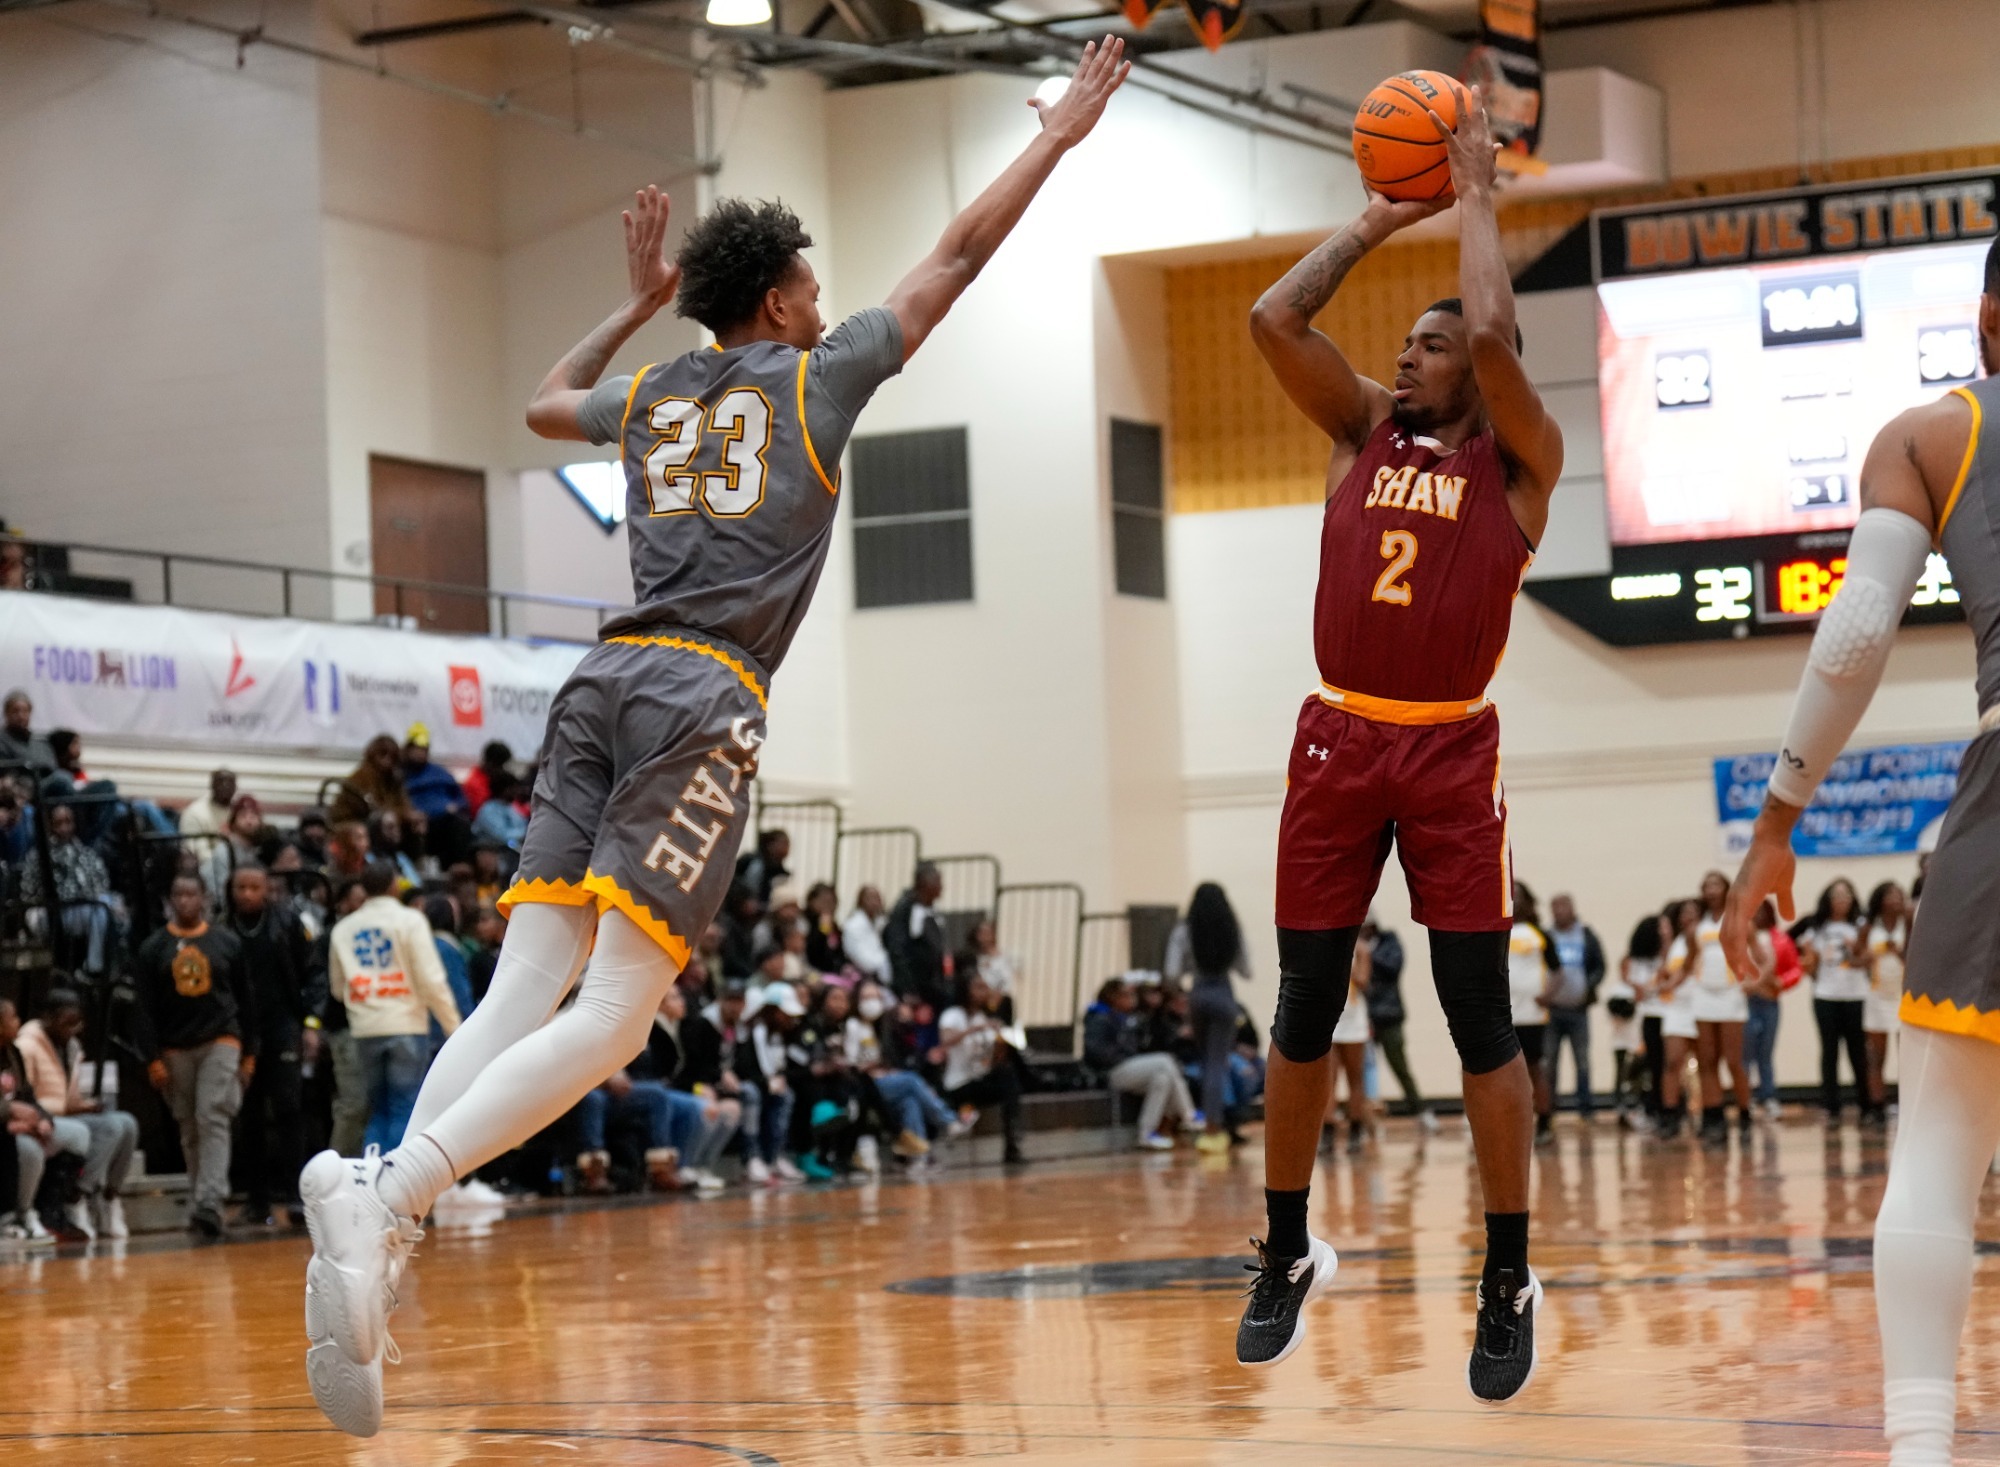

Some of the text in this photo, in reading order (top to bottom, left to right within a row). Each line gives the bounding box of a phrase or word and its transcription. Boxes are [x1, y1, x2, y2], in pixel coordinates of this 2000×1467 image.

[1360, 98, 1396, 119] EVO
[1624, 180, 1998, 270] BOWIE STATE
[643, 386, 774, 518] 23
[1364, 465, 1468, 521] SHAW
[1371, 529, 1419, 607] 2
[1694, 566, 1752, 622] 32
[33, 644, 178, 690] FOOD LION
[490, 684, 553, 716] TOYOT
